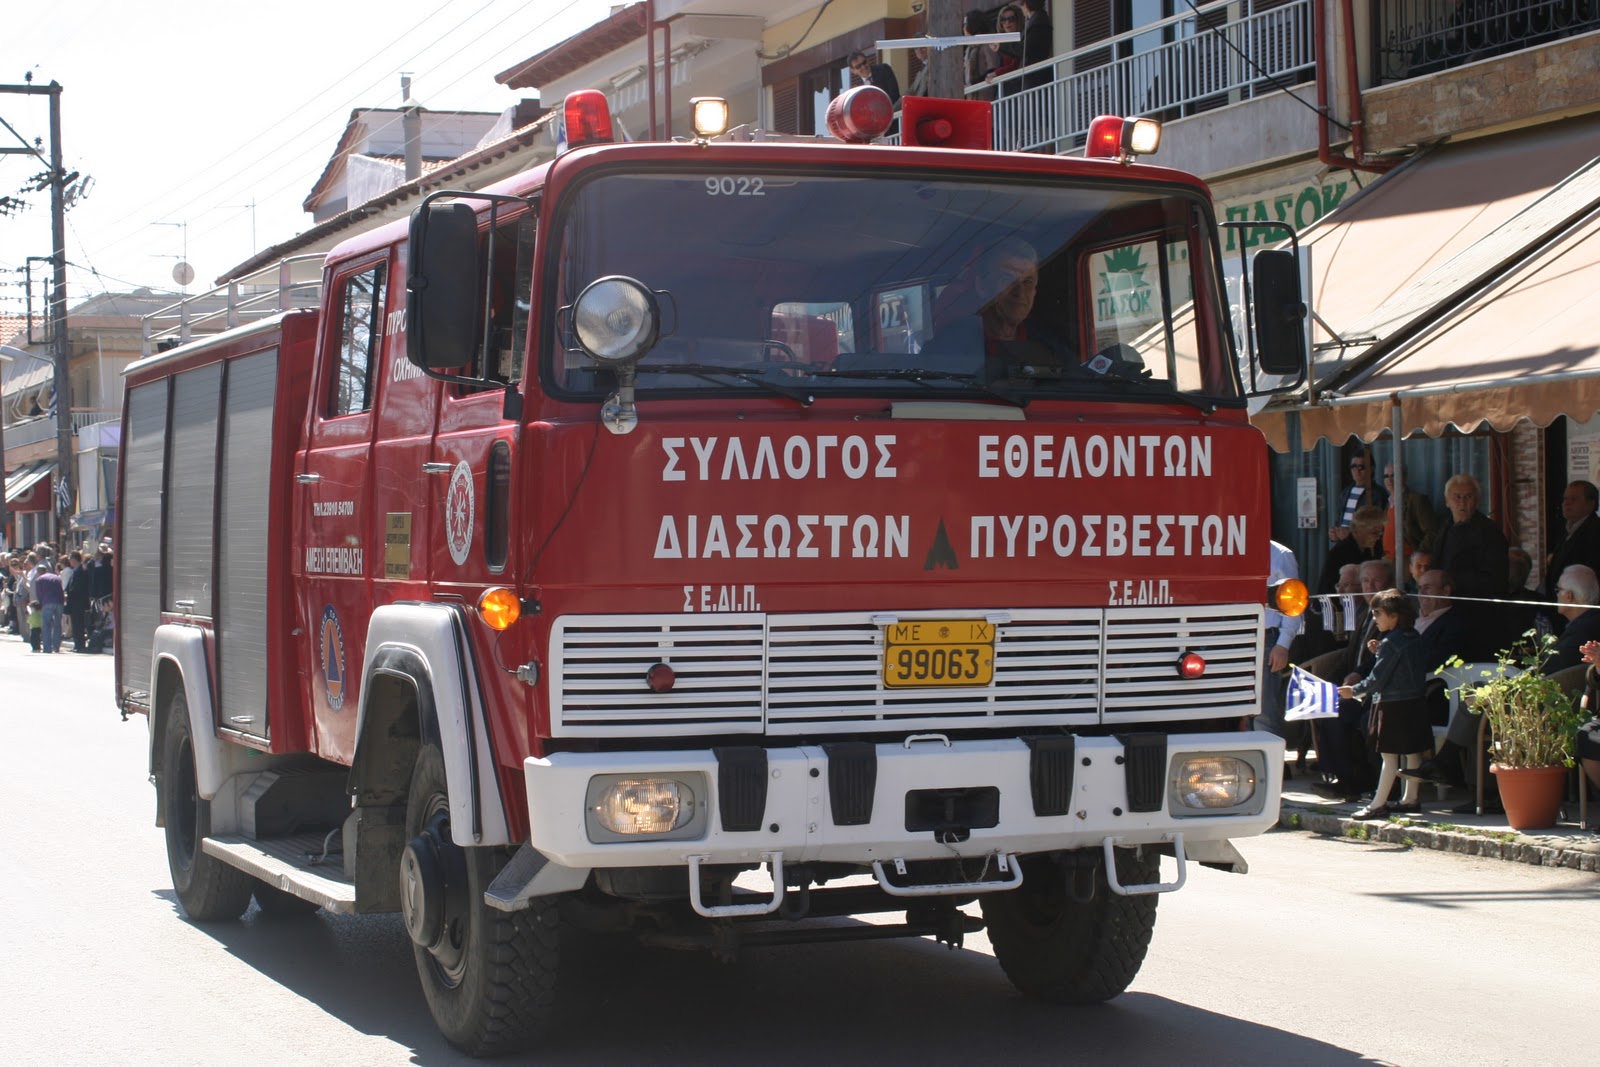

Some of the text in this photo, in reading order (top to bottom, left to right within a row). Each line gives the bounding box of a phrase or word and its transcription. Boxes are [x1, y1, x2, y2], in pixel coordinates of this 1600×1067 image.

[705, 176, 765, 196] 9022
[1097, 289, 1152, 322] ΠΑΣΟΚ
[385, 308, 407, 337] ΠΥΡΟ
[661, 434, 1212, 482] ΣΥΛΛΟΓΟΣ ΕΘΕΛΟΝΤΩΝ
[653, 513, 1247, 559] ΔΙΑΣΩΣΤΩΝ ΠΥΡΟΣΒΕΣΤΩΝ
[305, 547, 325, 573] ΑΜΕΣΗ
[326, 548, 363, 575] ΕΠΕΜΒΑΣΗ
[1108, 579, 1174, 606] Σ.Ε.ΔΙ.Π.
[897, 649, 980, 679] 99063
